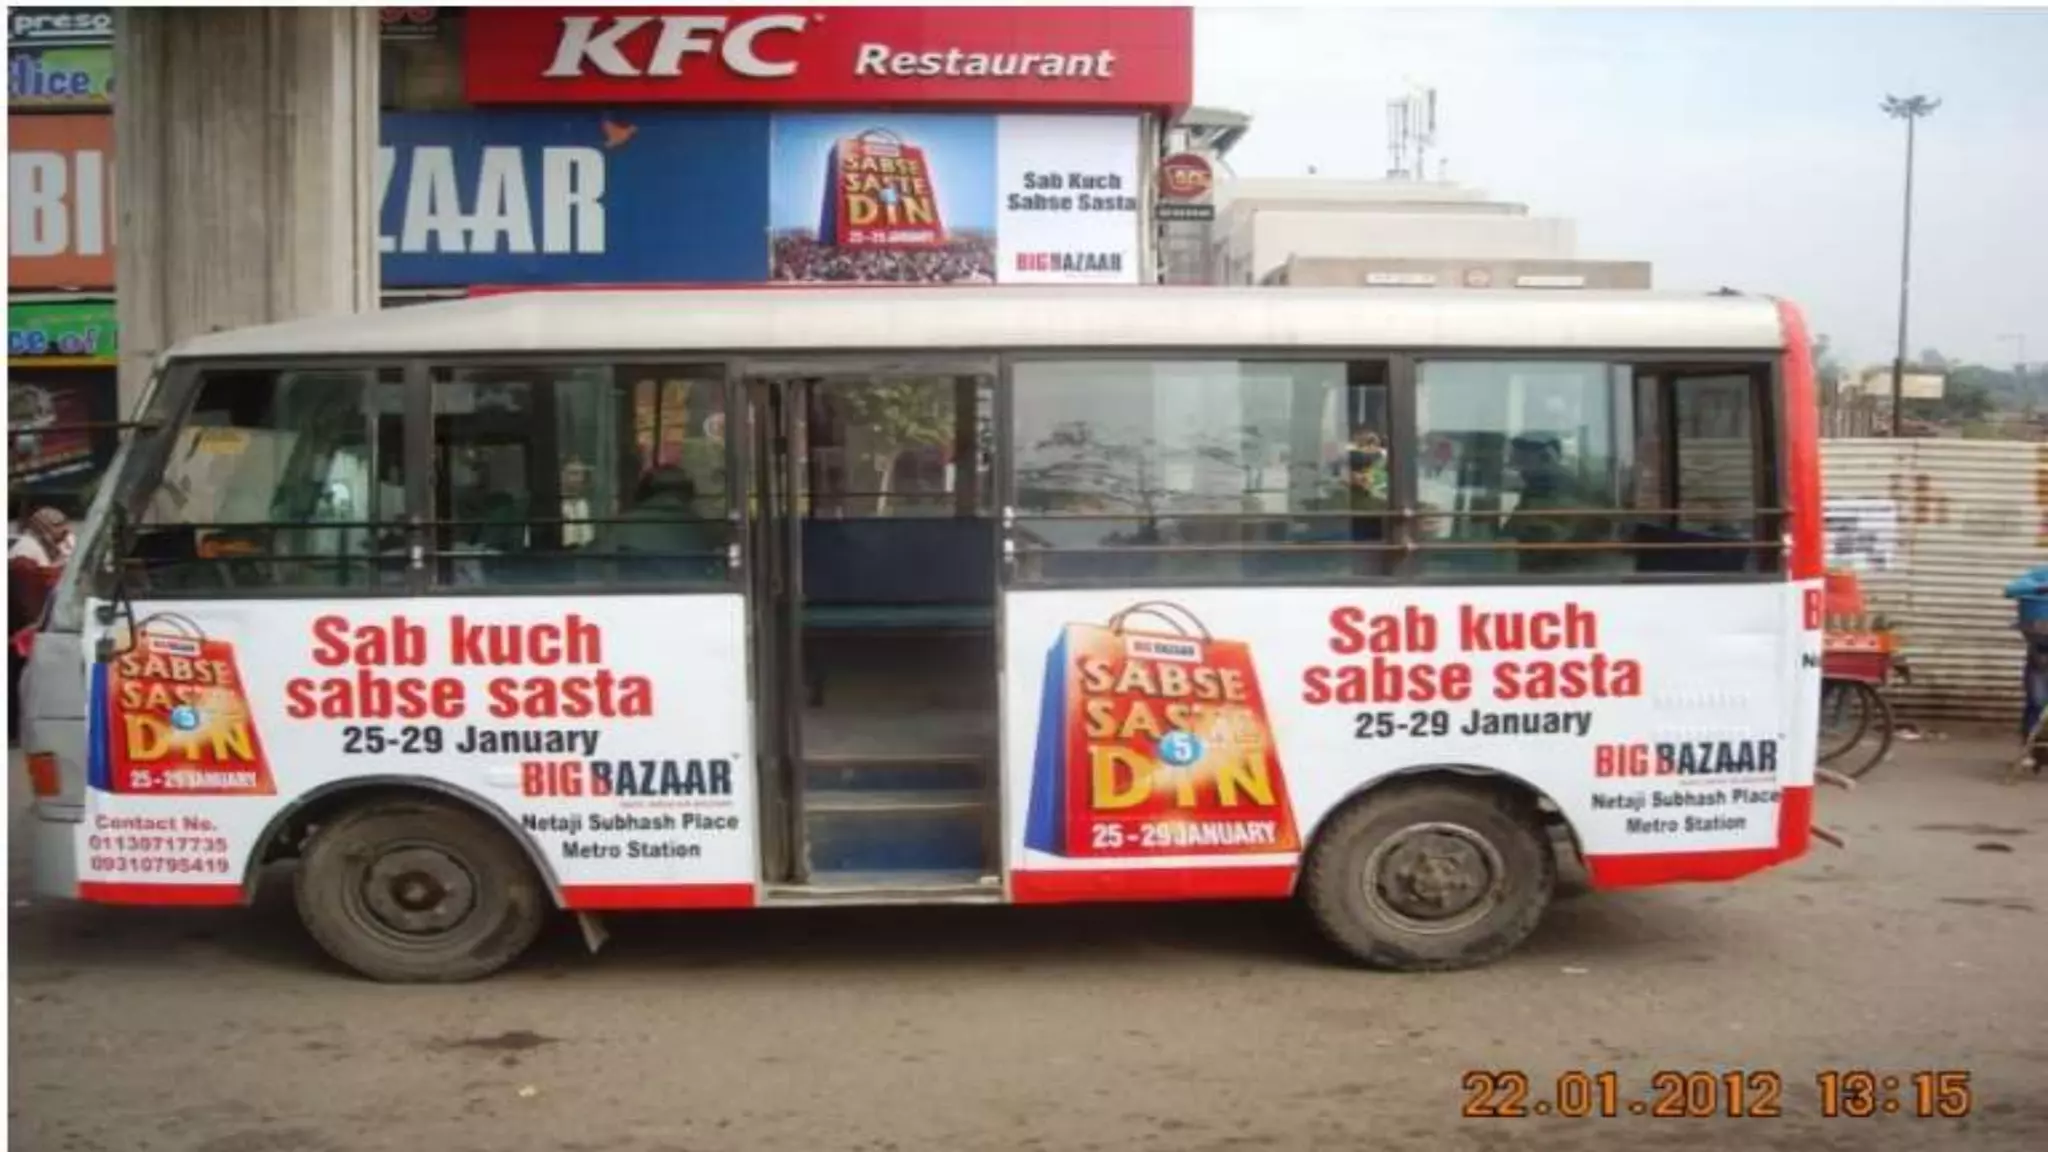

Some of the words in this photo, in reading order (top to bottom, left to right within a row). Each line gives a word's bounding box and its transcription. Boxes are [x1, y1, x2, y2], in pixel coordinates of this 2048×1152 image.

[8, 11, 112, 37] preso
[541, 13, 808, 77] KFC
[854, 42, 1116, 77] Restaurant
[1023, 171, 1063, 190] Sab
[1068, 171, 1122, 190] Kuch
[8, 149, 117, 256] BI
[846, 193, 936, 225] DIN
[1006, 192, 1073, 211] Sabse
[1077, 192, 1137, 211] Sasta
[1016, 252, 1048, 272] BIG
[1049, 251, 1122, 272] BAZAAR
[312, 615, 428, 666] Sab
[450, 614, 603, 665] kuch
[1328, 605, 1437, 654] Sab
[1459, 602, 1597, 651] kuch
[120, 651, 233, 685] SABSE
[1080, 657, 1249, 701] SABSE
[1302, 655, 1473, 704] sabse
[1492, 653, 1643, 700] sasta
[285, 669, 466, 719] sabse
[487, 668, 653, 719] sasta
[1354, 711, 1449, 739] 25-29
[1460, 708, 1593, 737] January
[342, 726, 443, 754] 25-29
[456, 726, 601, 757] January
[1594, 743, 1648, 778] BIG
[1655, 739, 1777, 776] BAZAAR
[522, 761, 584, 797] BIG
[590, 759, 733, 797] BAZAAR
[1089, 744, 1278, 809] DIN
[1591, 792, 1647, 812] Netaji
[1652, 788, 1727, 808] Subhash
[1733, 786, 1781, 805] Place
[95, 814, 177, 831] Contact
[522, 814, 583, 835] Netaji
[588, 813, 676, 831] Subhash
[682, 813, 739, 831] Place
[1172, 820, 1277, 847] JANUARY
[1625, 817, 1680, 835] Metro
[1684, 815, 1748, 833] Station
[563, 841, 622, 859] Metro
[627, 841, 703, 860] Station
